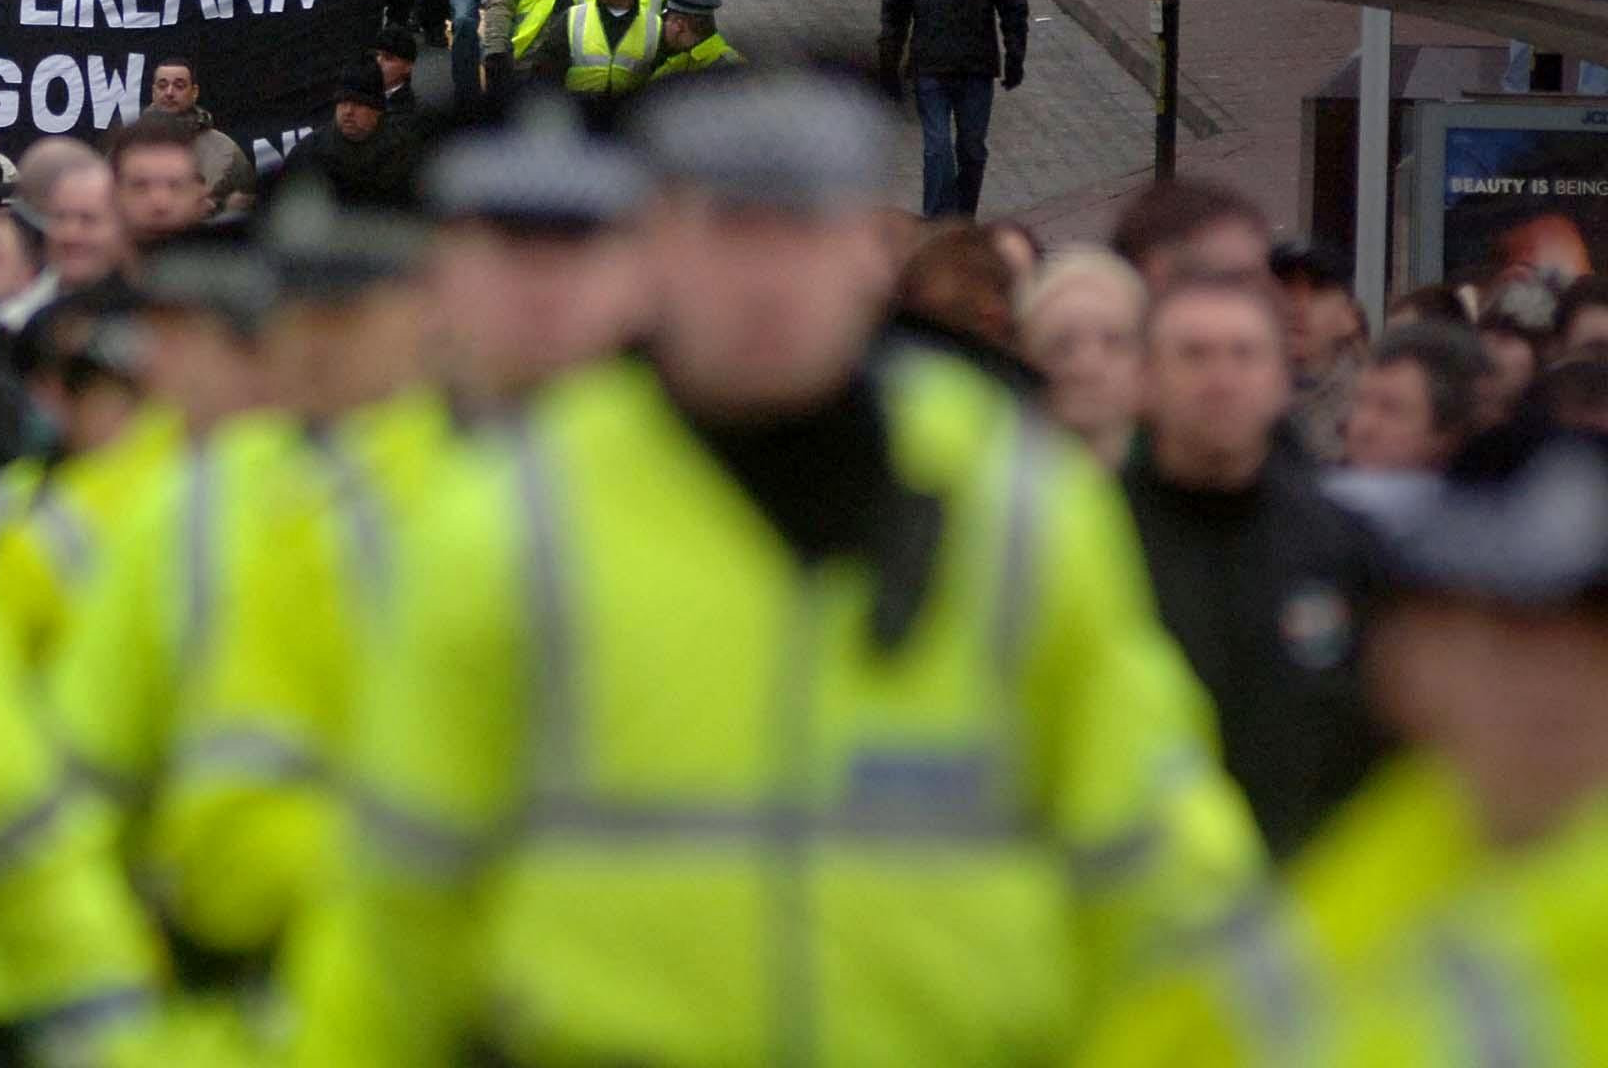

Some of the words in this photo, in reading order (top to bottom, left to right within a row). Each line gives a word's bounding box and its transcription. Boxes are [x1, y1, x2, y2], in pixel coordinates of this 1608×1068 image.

[1451, 178, 1526, 195] BEAUTY
[1531, 178, 1550, 195] IS
[1555, 179, 1608, 197] BEING
